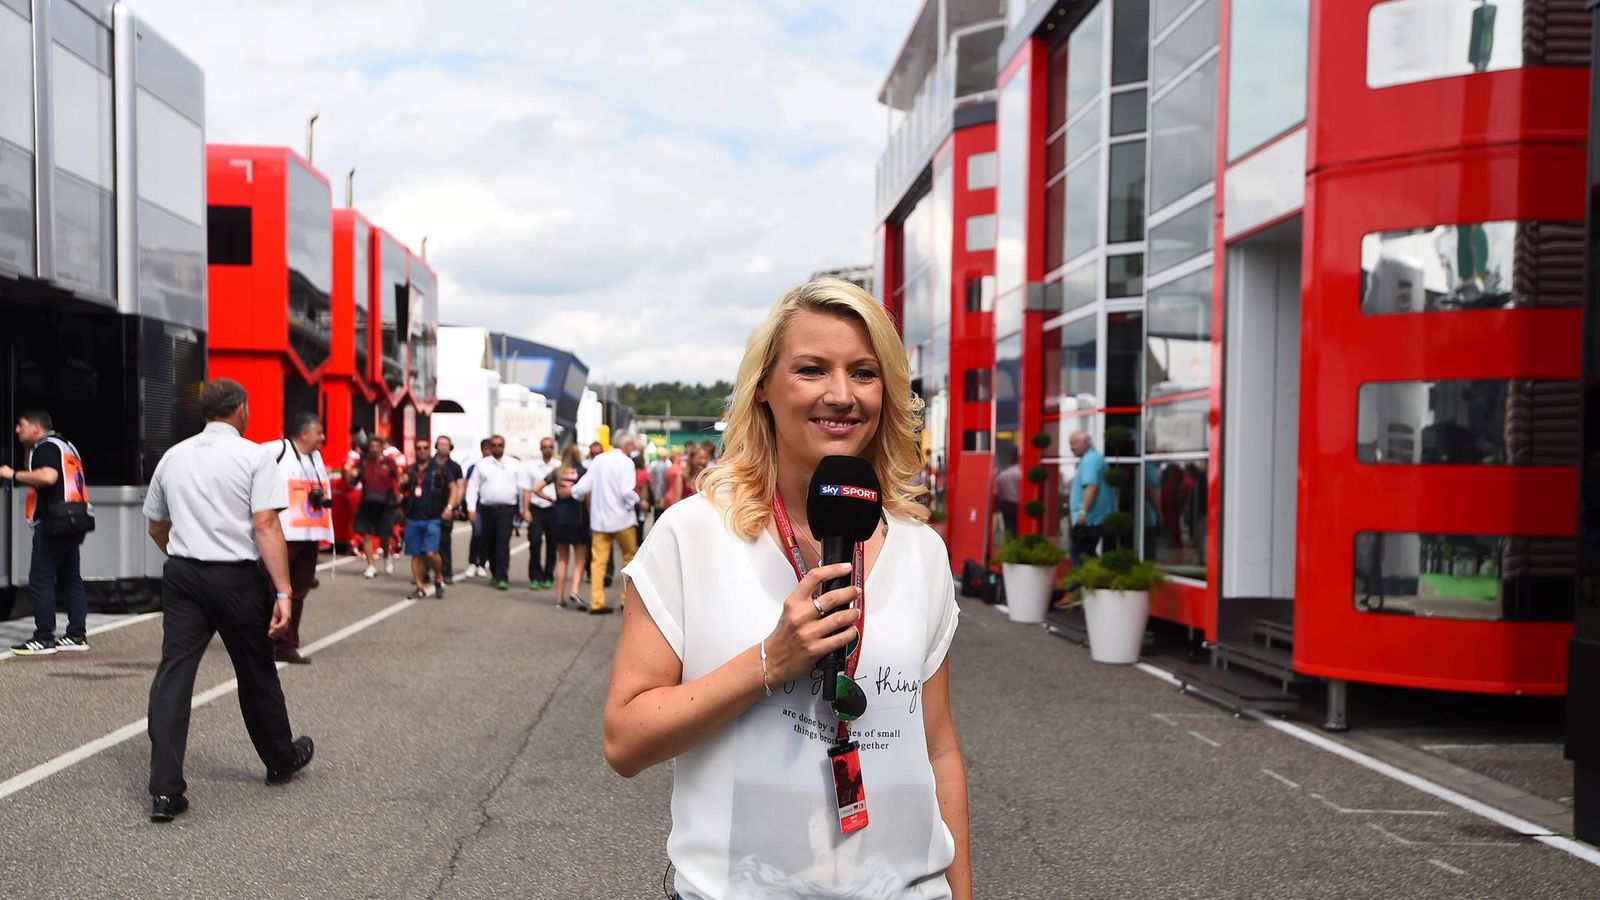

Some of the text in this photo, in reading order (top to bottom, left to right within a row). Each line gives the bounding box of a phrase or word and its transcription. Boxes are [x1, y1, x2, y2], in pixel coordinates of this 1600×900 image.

[822, 485, 876, 499] sky SPORT
[782, 708, 797, 718] are
[798, 713, 816, 726] done
[818, 720, 828, 731] by
[848, 728, 861, 737] ies
[864, 729, 875, 737] of
[877, 729, 900, 737] small
[793, 724, 889, 751] things brou gether
